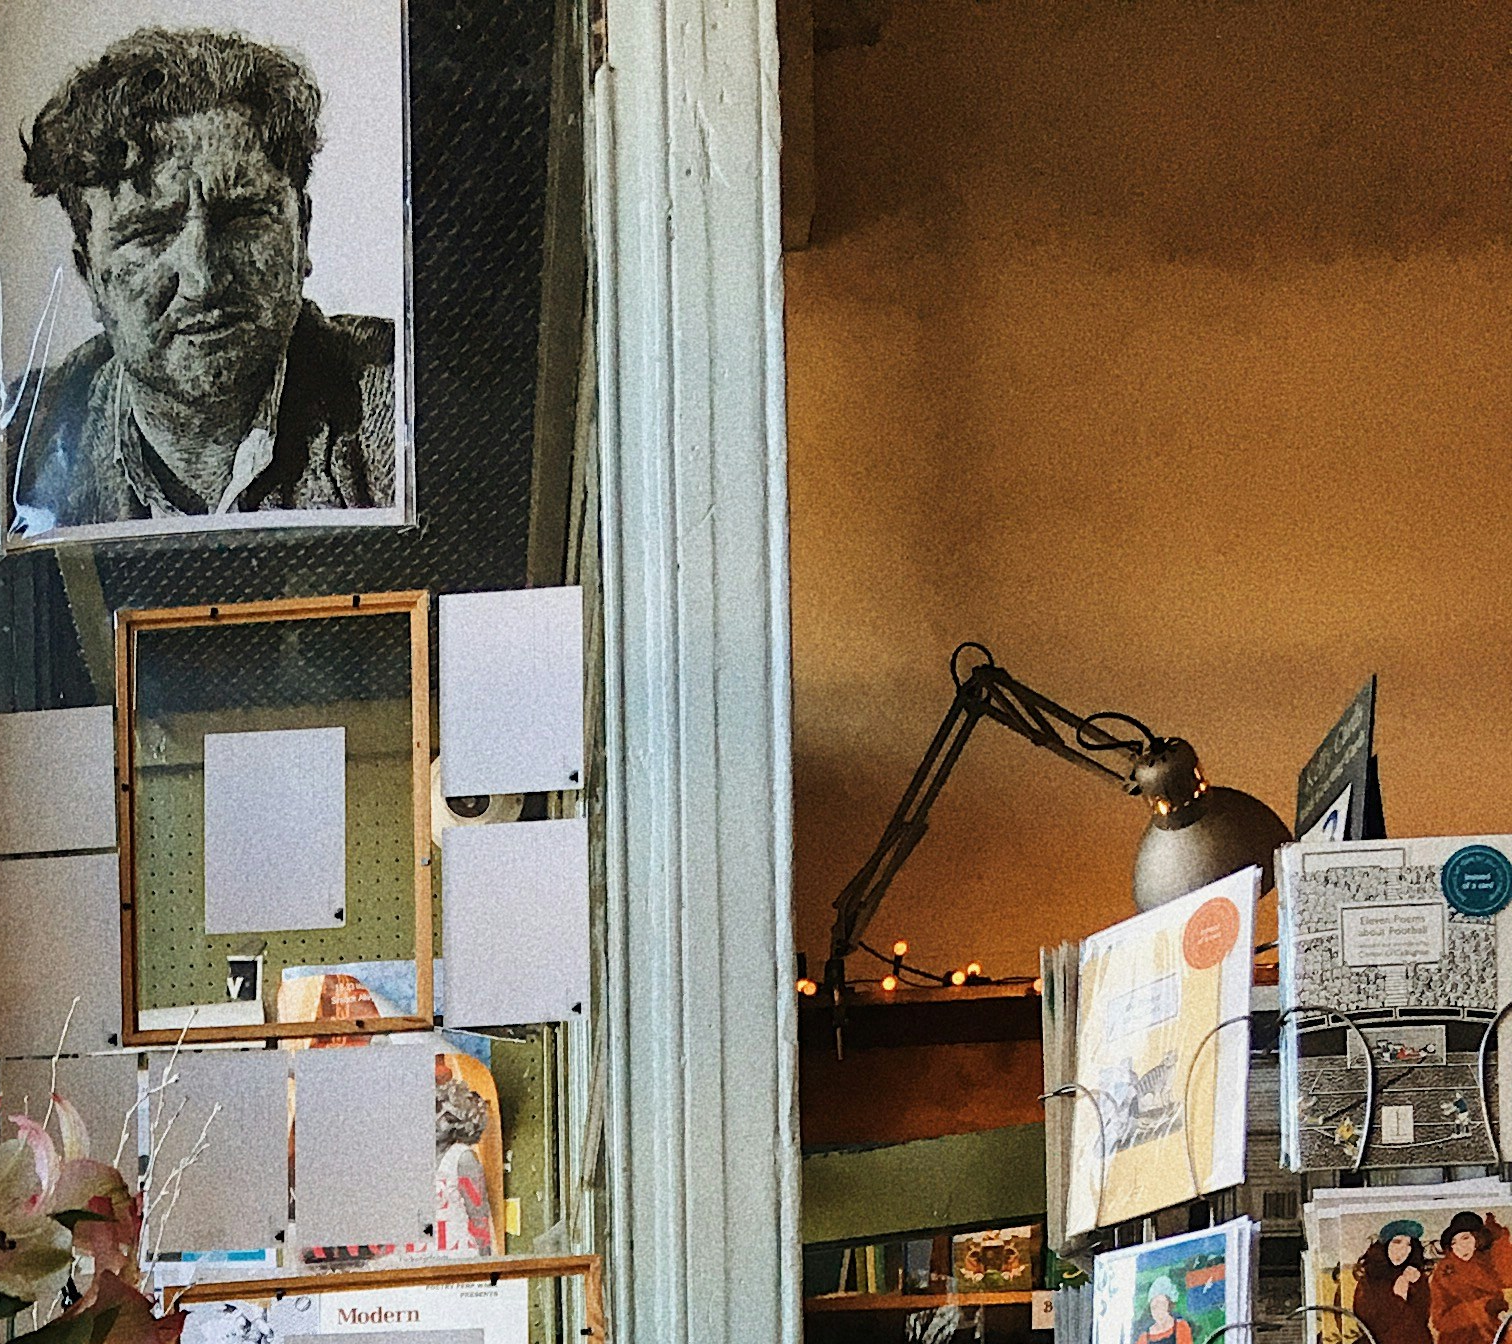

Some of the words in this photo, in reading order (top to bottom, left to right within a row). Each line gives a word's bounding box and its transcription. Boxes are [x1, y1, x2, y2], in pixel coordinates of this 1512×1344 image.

[1393, 914, 1426, 924] Poems
[1389, 926, 1428, 936] Football
[337, 1307, 420, 1325] Modern
